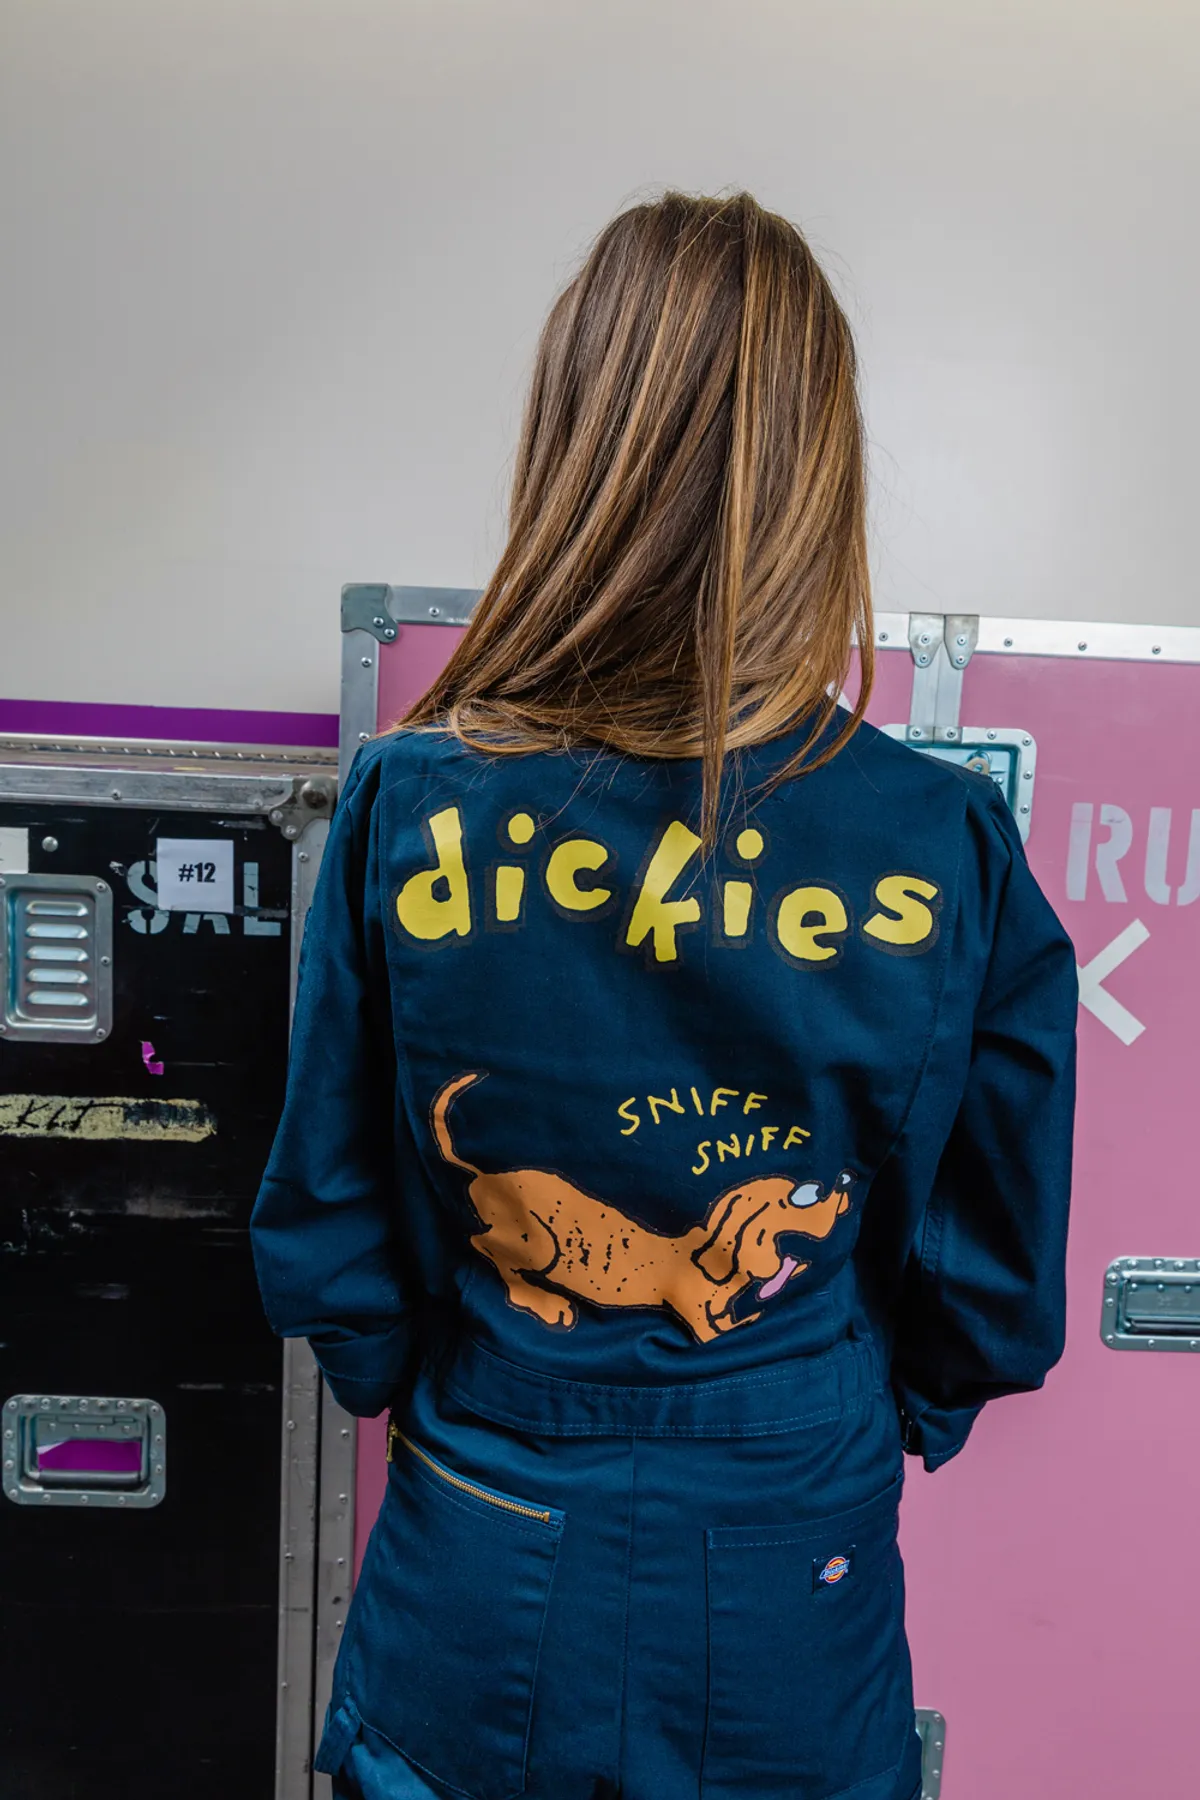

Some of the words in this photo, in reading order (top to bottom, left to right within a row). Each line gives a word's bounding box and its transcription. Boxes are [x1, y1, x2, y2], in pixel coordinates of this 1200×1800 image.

[178, 861, 216, 883] #12
[396, 806, 939, 963] dickies
[617, 1086, 768, 1136] SNIFF
[691, 1125, 811, 1175] SNIFF
